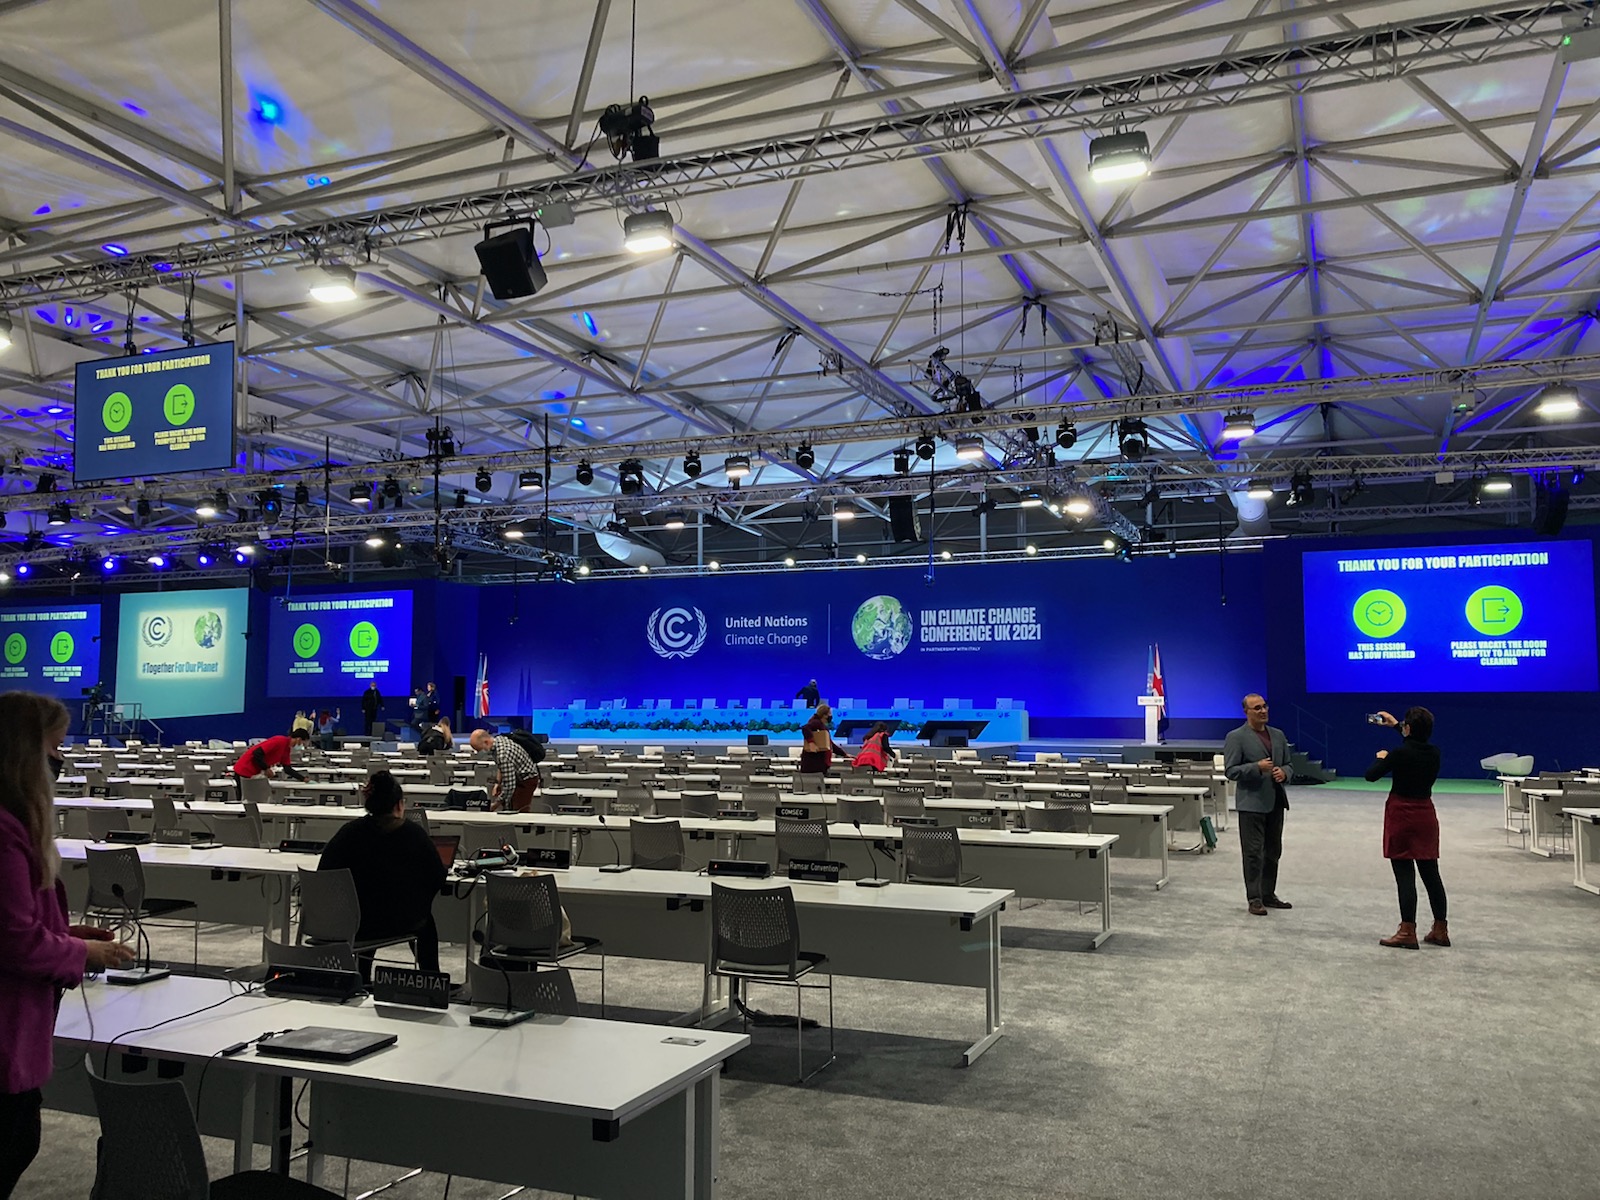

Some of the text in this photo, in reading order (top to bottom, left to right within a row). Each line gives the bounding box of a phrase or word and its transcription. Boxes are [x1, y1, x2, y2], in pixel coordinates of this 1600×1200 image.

[96, 355, 210, 379] THANK YOU FOR YOUR PARTICIPATION
[1338, 552, 1548, 572] THANK YOU FOR YOUR PARTICIPATION
[725, 616, 808, 628] United Nations
[921, 607, 1036, 625] UN CLIMATE CHANGE
[725, 633, 808, 647] Climate Change
[921, 624, 1041, 642] CONFERENCE UK 2021
[1523, 640, 1547, 648] ROOM
[1382, 650, 1415, 659] FINISHED
[1480, 657, 1518, 666] CLEANING
[790, 861, 838, 872] Ramsar Convention
[376, 971, 448, 991] UN-HABITAT
